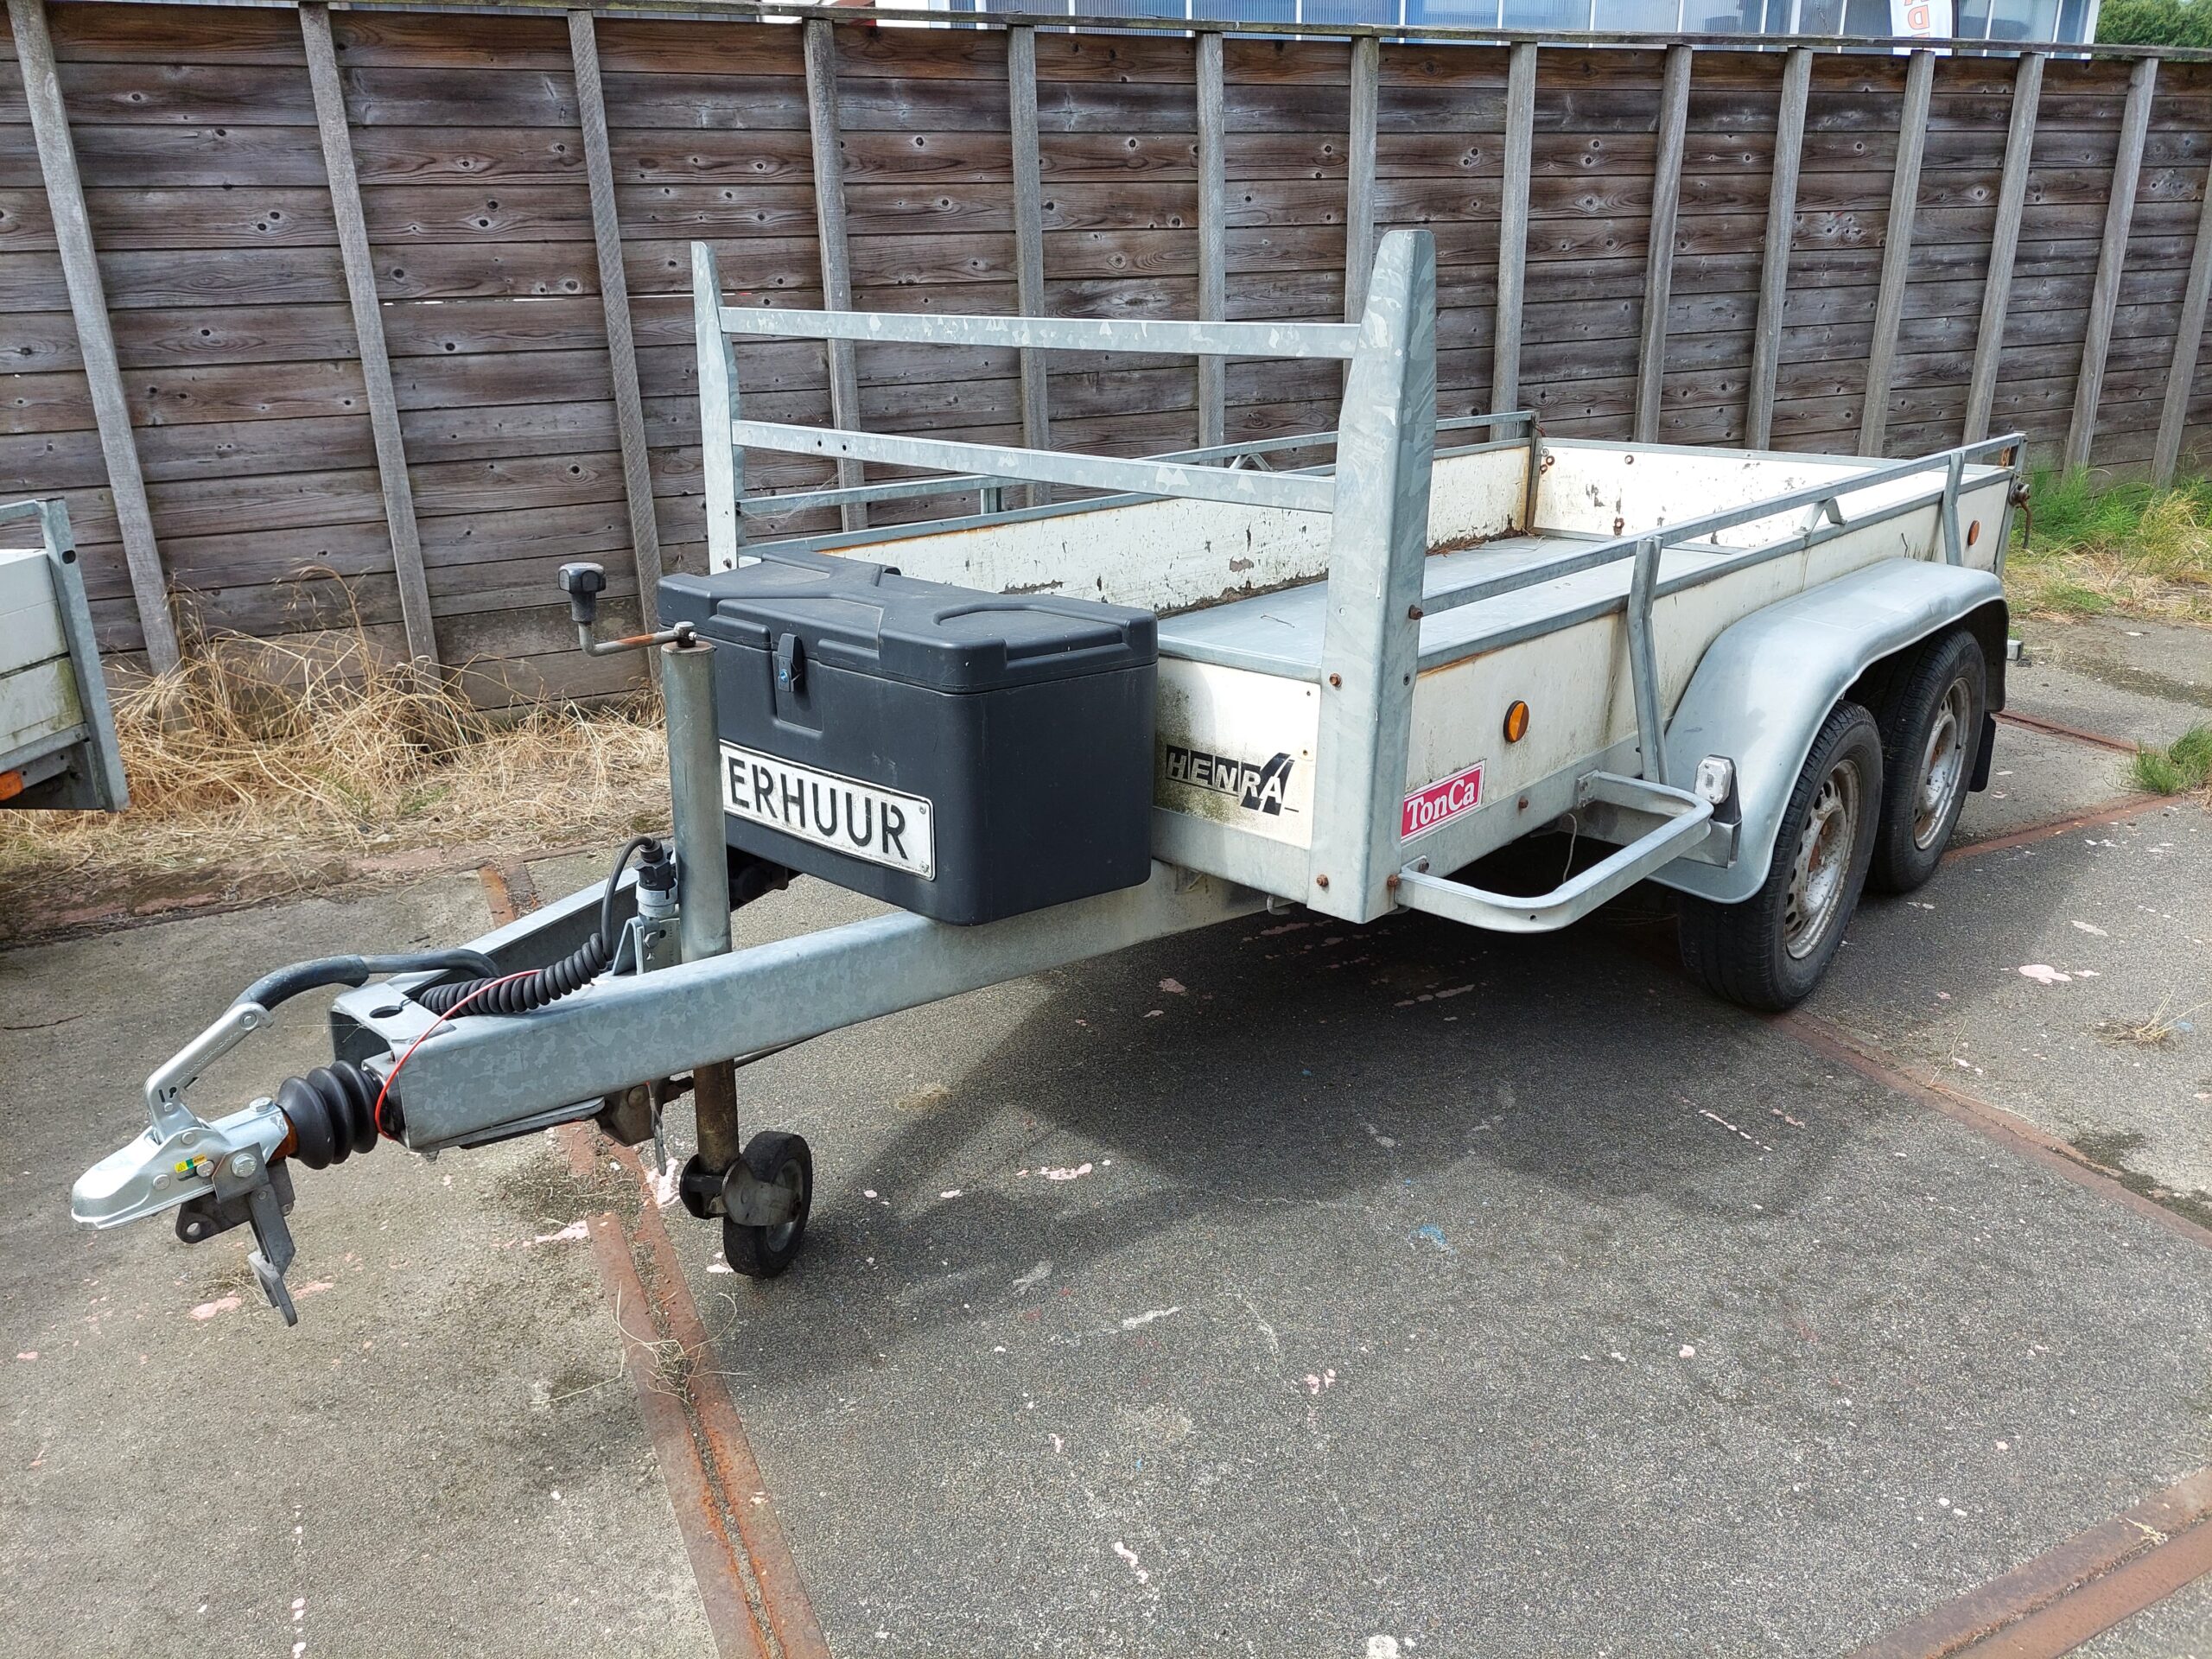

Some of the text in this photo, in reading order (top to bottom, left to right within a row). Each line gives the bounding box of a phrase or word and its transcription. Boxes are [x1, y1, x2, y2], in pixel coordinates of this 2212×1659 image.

[722, 753, 908, 860] ERHUUR
[1166, 748, 1285, 807] HENRA
[1408, 777, 1476, 830] TonCa
